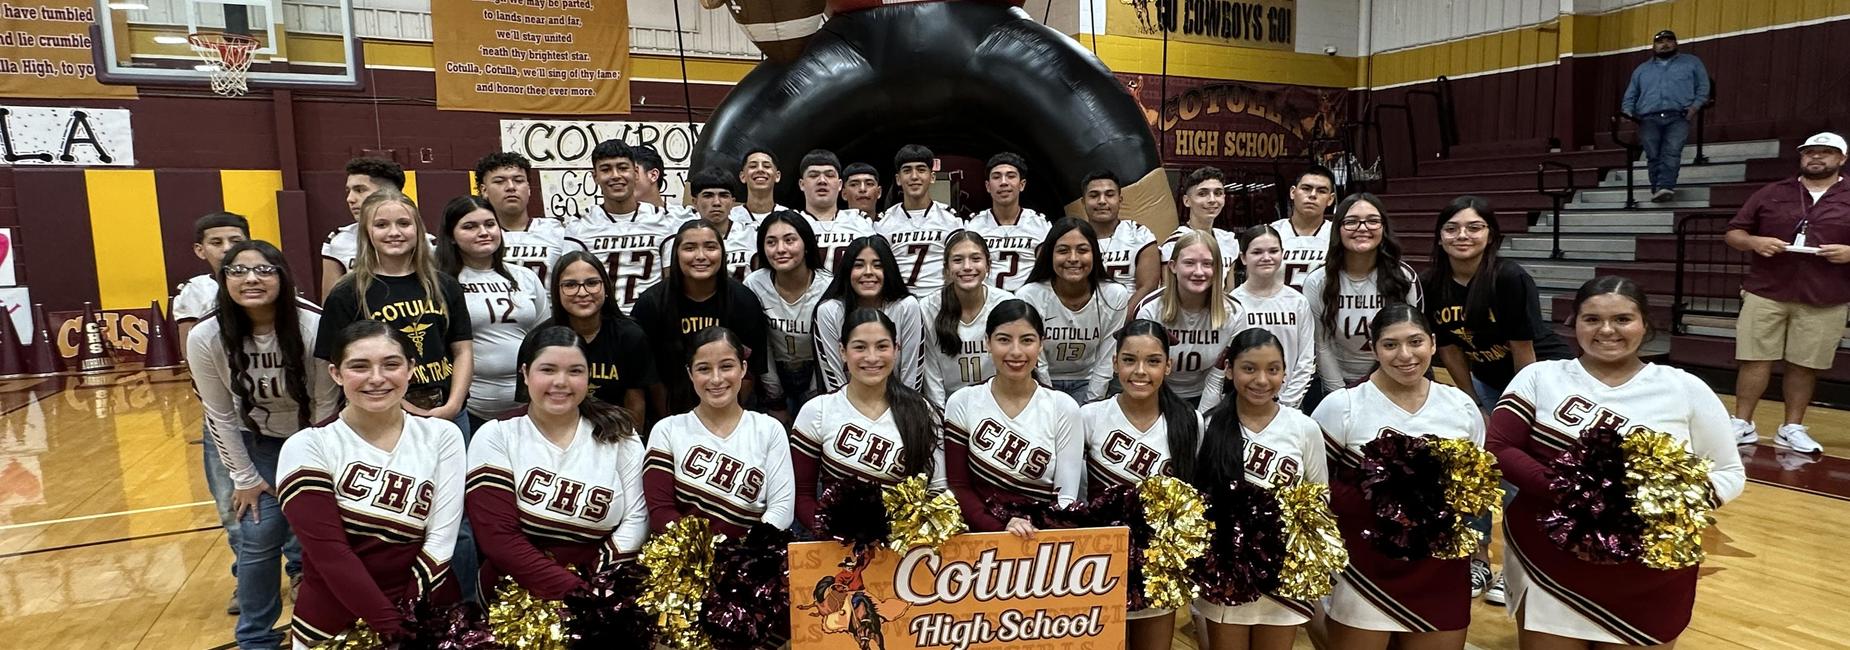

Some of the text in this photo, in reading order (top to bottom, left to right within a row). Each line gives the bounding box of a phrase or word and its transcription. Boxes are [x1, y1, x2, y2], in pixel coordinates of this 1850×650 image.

[4, 3, 94, 21] have tumbled
[562, 0, 593, 10] parted,
[483, 9, 494, 19] to
[496, 10, 521, 22] lands
[525, 16, 545, 25] near
[548, 15, 565, 25] and
[1183, 0, 1263, 41] COWBOYS
[1267, 6, 1292, 44] GO!
[18, 32, 34, 47] lie
[39, 34, 92, 48] crumble
[497, 30, 572, 44] we'll stay united
[512, 48, 526, 60] thy
[529, 49, 569, 62] brightest
[571, 52, 590, 61] star.
[22, 60, 58, 77] High,
[61, 62, 74, 75] to
[446, 63, 482, 74] Cotulla,
[485, 64, 520, 76] Cotulla,
[523, 68, 545, 78] we'll
[548, 69, 567, 80] sing
[569, 68, 579, 78] of
[580, 68, 594, 80] thy
[476, 83, 596, 96] and honor thee ever more.
[1175, 129, 1288, 158] HIGH SCHOOL
[594, 236, 655, 250] COTULLA
[891, 231, 943, 244] COTULLA
[906, 245, 930, 287] 7
[1338, 294, 1383, 309] OTULLA
[485, 298, 518, 325] 12
[1247, 312, 1296, 326] OTULLA
[86, 322, 103, 354] CHS
[1044, 326, 1099, 341] COTULLA
[1167, 328, 1220, 345] OTULLA
[1056, 342, 1086, 362] 13
[958, 356, 981, 383] 11
[1176, 351, 1202, 373] 10
[972, 417, 1052, 480] CHS
[681, 444, 765, 504] CHS
[337, 460, 436, 521] CHS
[517, 466, 614, 523] CHS
[894, 541, 1119, 606] Cotulla
[909, 603, 996, 650] High
[997, 605, 1104, 642] School
